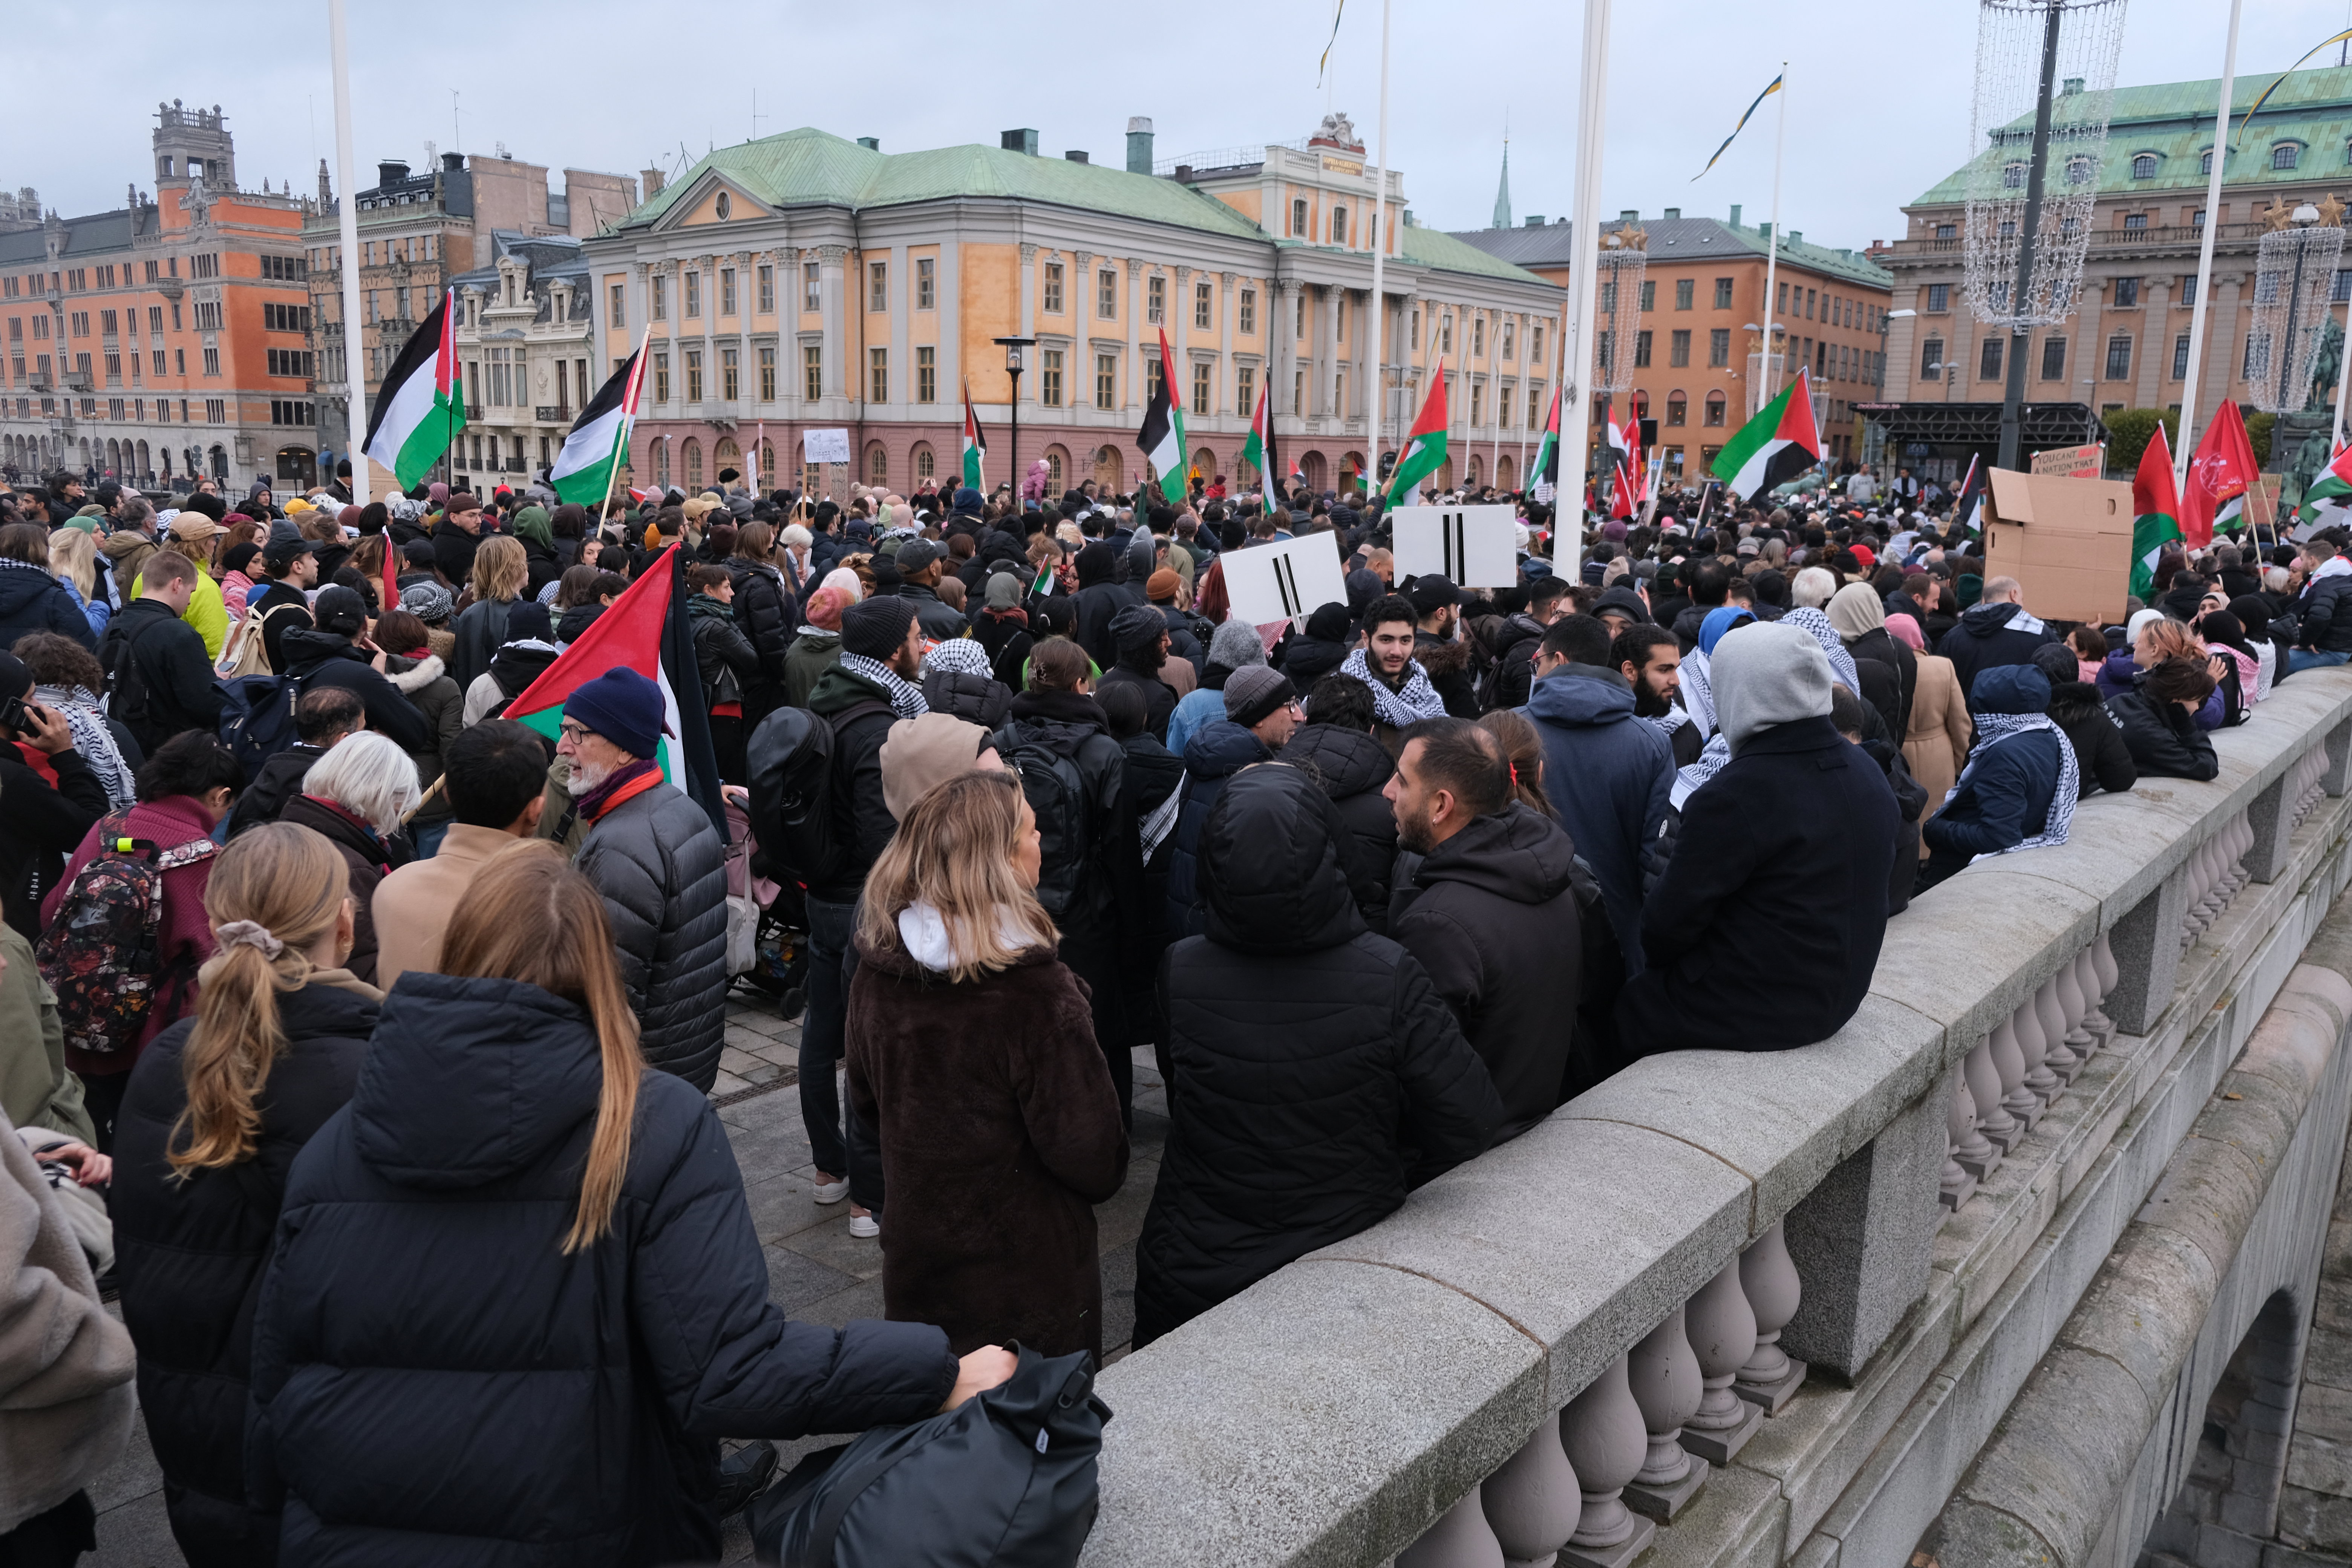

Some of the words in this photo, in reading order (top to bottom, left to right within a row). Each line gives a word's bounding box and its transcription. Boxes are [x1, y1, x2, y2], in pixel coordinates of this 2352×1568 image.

[2037, 454, 2055, 464] YOU
[2056, 450, 2078, 461] CANT
[2043, 462, 2072, 474] NATION
[2074, 458, 2094, 469] THAT
